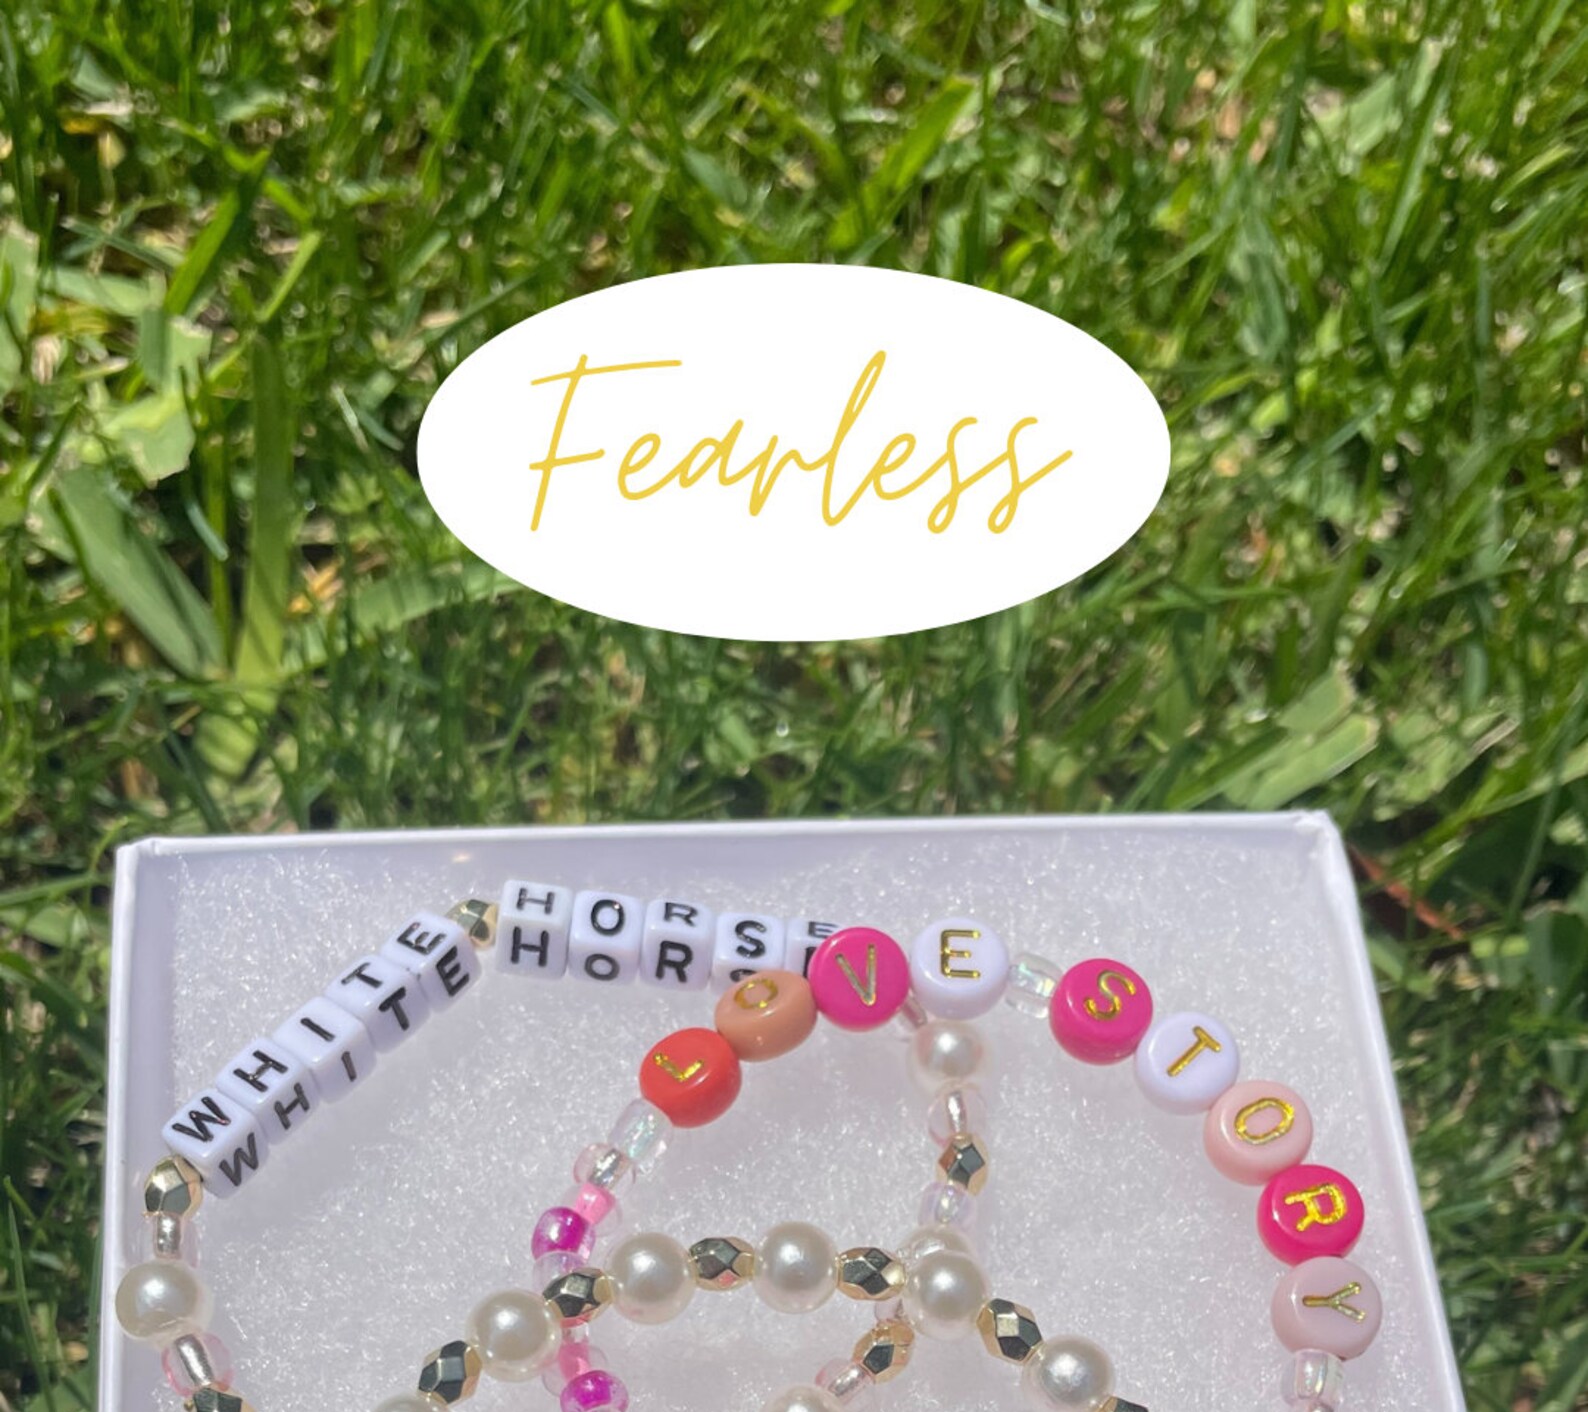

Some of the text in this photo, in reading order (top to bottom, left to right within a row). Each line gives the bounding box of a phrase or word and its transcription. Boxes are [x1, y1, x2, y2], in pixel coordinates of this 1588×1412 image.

[171, 921, 446, 1143] WHITE
[218, 926, 814, 1187] WHITE HOR
[653, 928, 1367, 1323] LOVE STORY
